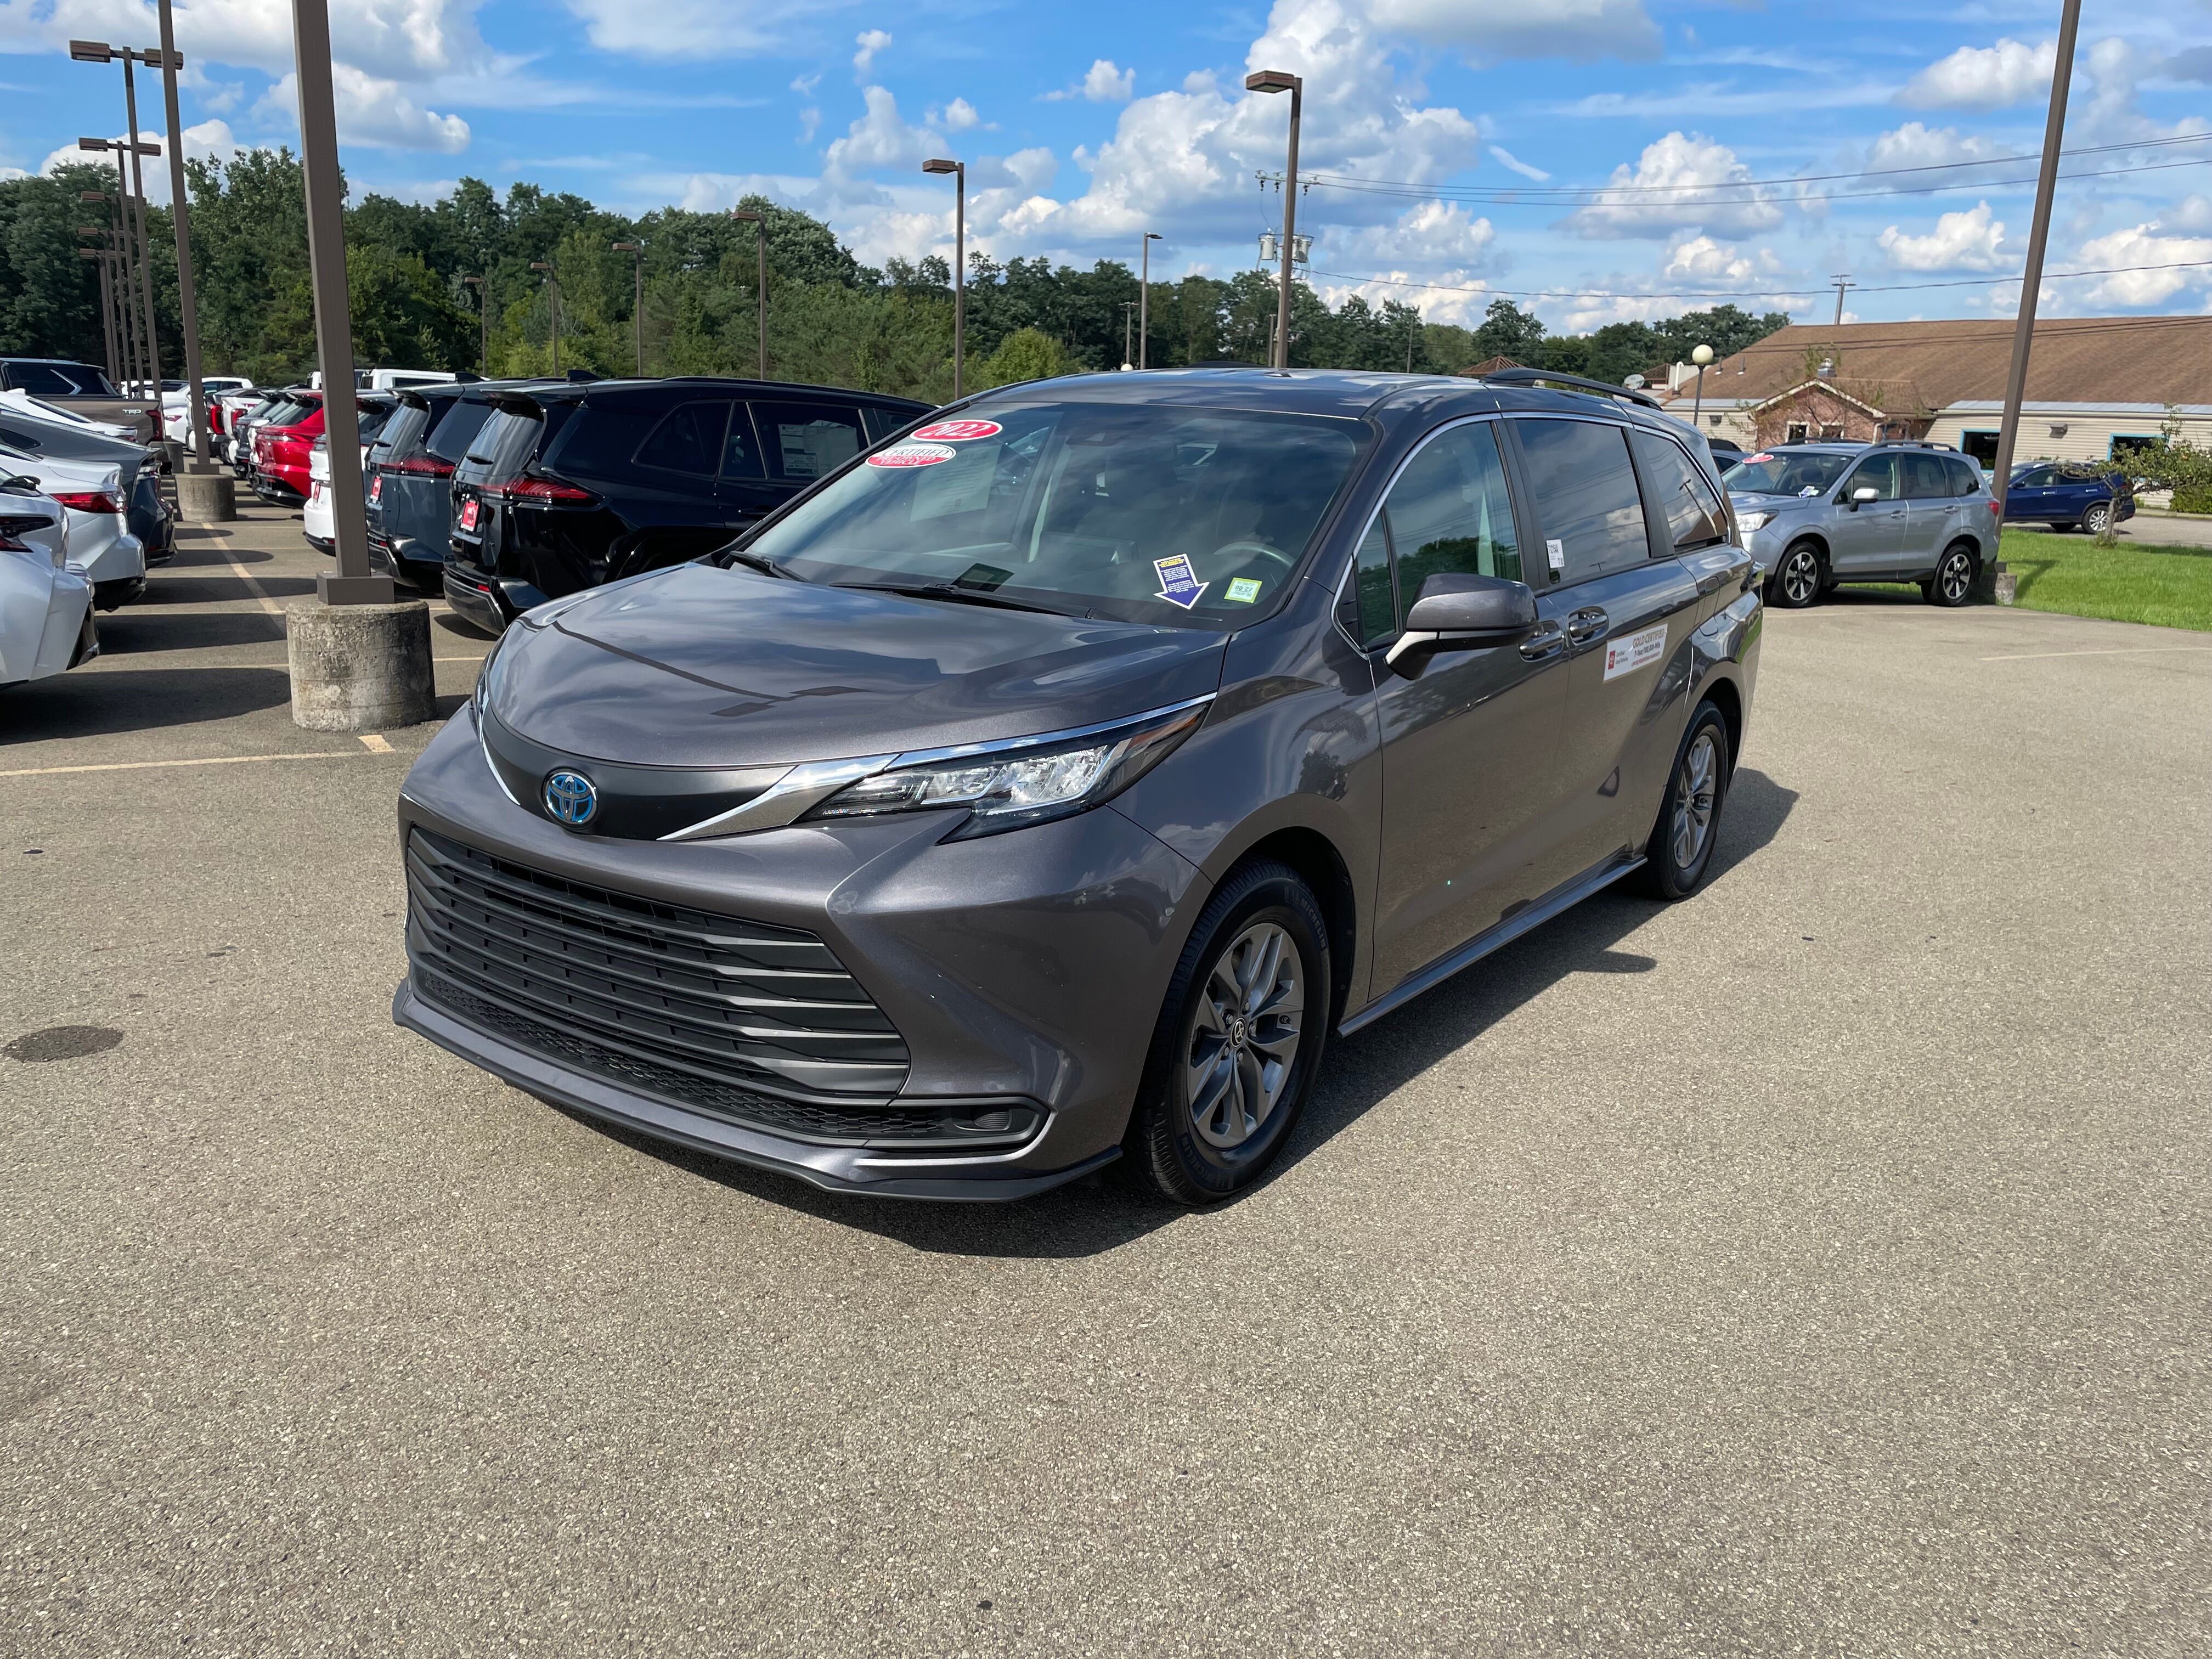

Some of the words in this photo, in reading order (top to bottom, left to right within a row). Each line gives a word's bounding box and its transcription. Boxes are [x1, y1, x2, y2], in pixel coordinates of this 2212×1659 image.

[919, 424, 991, 437] 2022
[882, 448, 950, 456] CERTIFIED
[1633, 635, 1645, 648] GOLD
[1300, 898, 1325, 948] MICHELIN
[1181, 1136, 1215, 1183] MICHELIN
